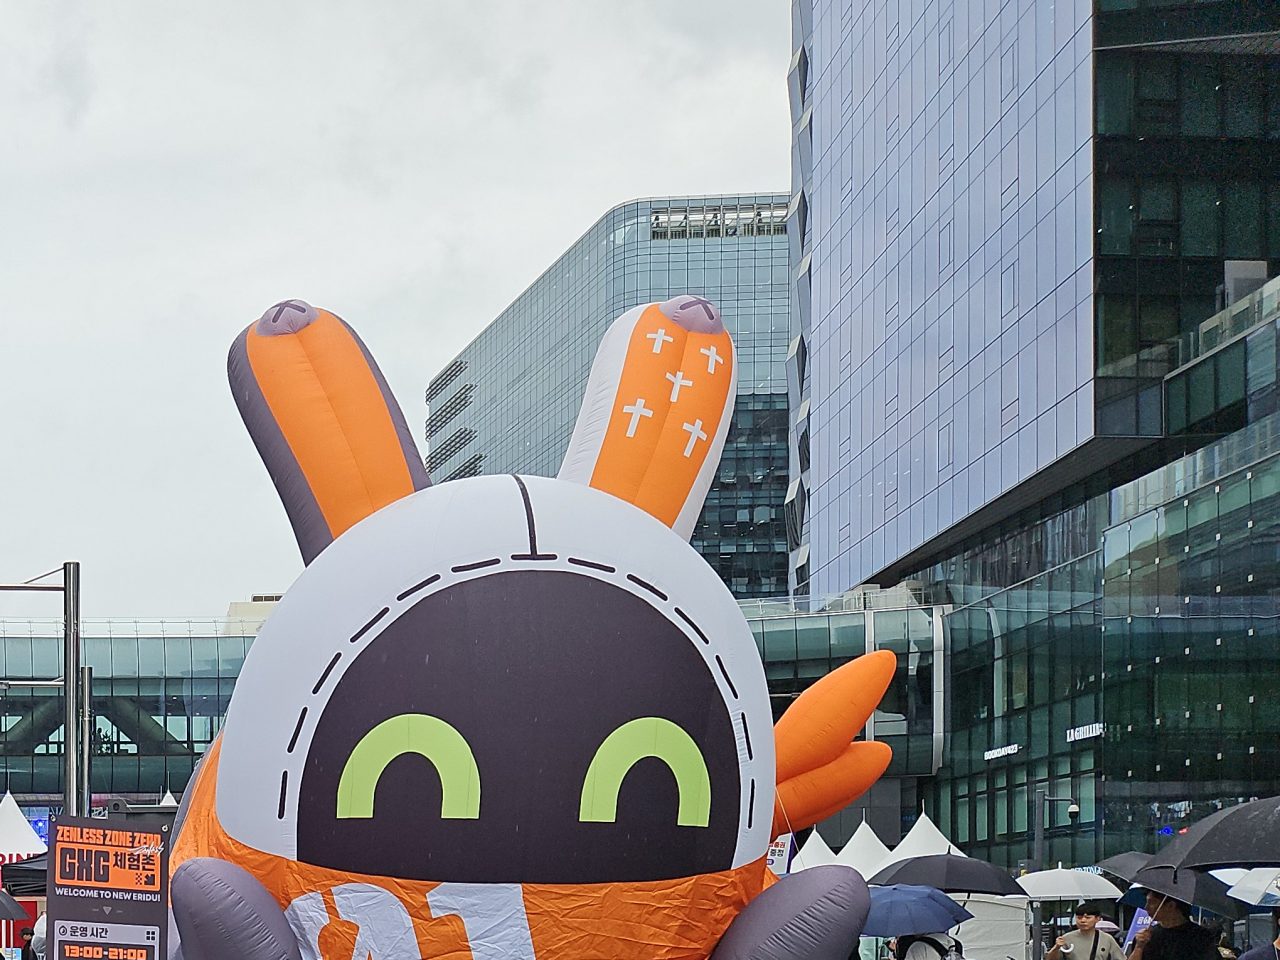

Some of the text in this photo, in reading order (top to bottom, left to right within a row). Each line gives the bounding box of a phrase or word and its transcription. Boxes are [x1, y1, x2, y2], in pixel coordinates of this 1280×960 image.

[56, 825, 161, 847] ZENLESS ZONE ZERO
[60, 847, 109, 883] GXG
[113, 851, 155, 871] 체험존
[55, 887, 161, 902] WELCOME TO NEW ERIDU!
[70, 926, 108, 939] 운영 시간
[64, 945, 147, 960] 13:00-21:00
